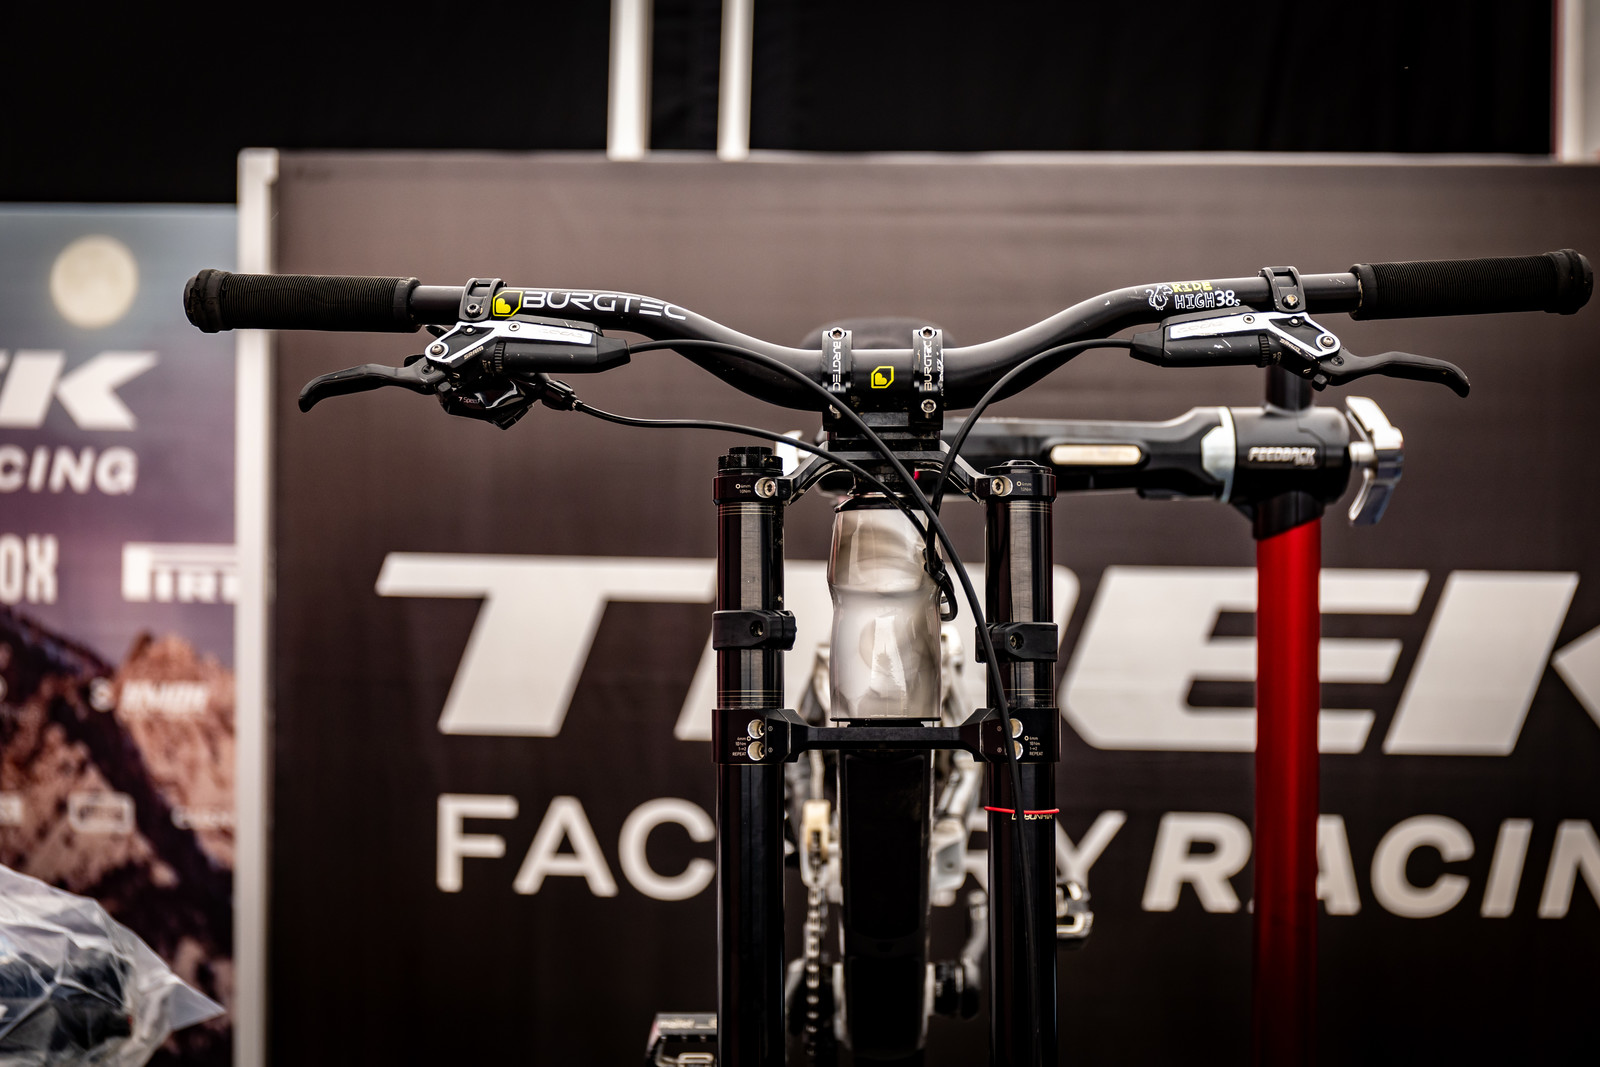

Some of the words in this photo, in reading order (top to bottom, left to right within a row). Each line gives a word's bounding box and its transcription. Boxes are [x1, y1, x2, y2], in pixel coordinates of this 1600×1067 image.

[523, 291, 686, 320] BURGTEC
[1171, 282, 1213, 292] RIDE
[832, 341, 842, 392] BURGTEC
[923, 340, 933, 391] BURGTEC
[1249, 447, 1316, 462] FEEDBACK
[435, 794, 1128, 904] FACY
